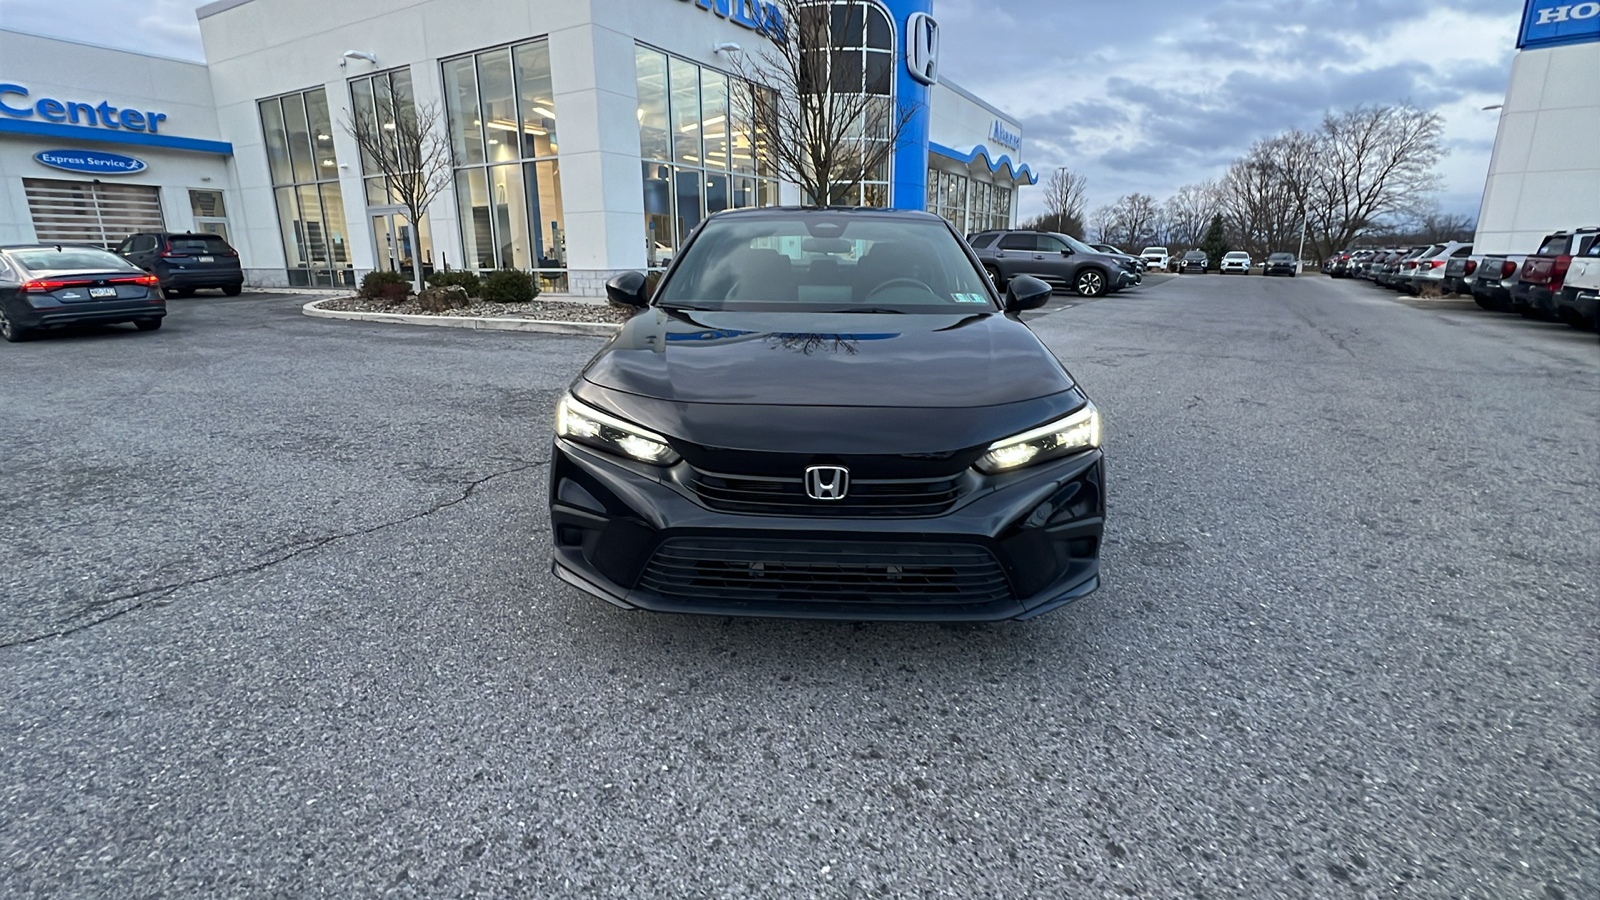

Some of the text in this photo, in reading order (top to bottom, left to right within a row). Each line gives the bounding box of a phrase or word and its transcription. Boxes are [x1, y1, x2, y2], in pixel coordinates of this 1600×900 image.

[0, 83, 167, 133] Center
[42, 153, 126, 167] Express Service
